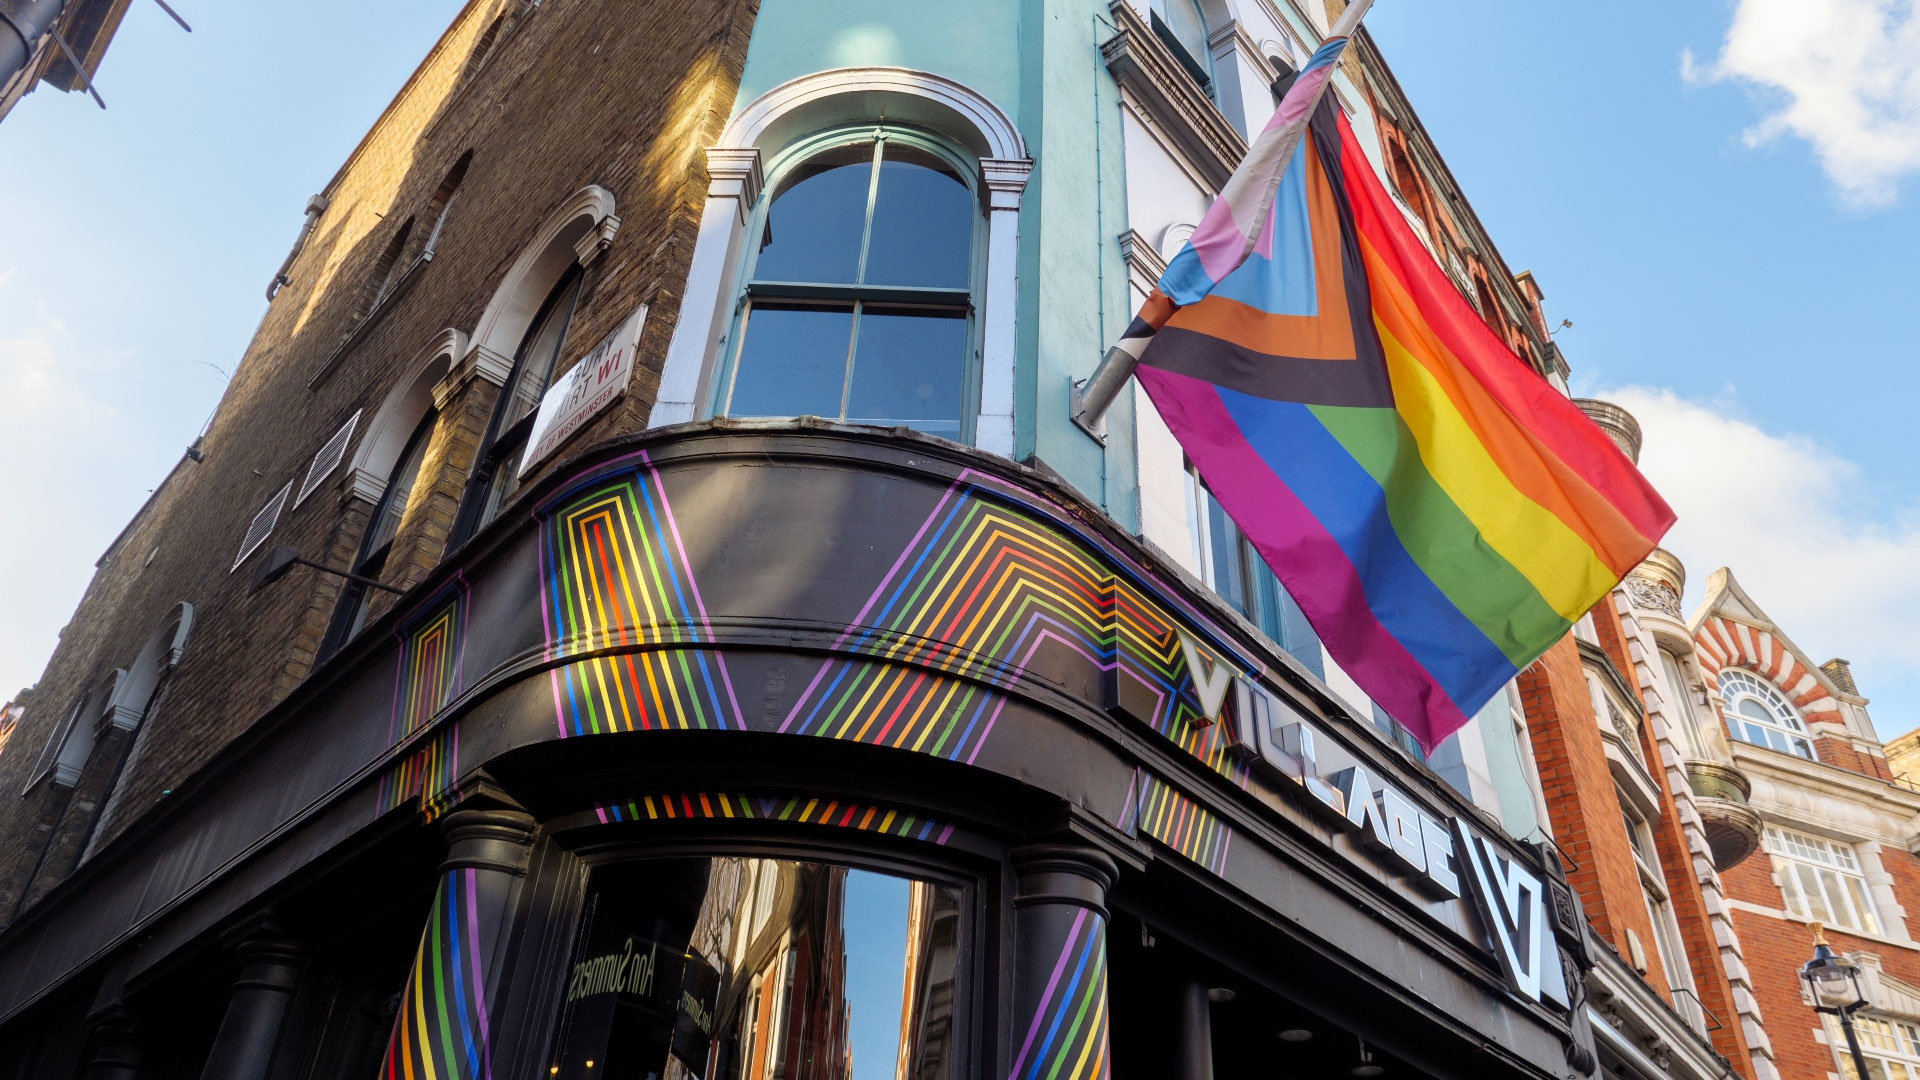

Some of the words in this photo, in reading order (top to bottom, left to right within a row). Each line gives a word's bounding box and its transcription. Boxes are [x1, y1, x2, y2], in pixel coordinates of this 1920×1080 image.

[597, 349, 622, 385] W1
[527, 444, 545, 465] CITY
[545, 433, 557, 449] OF
[557, 386, 613, 440] WESTMINSTER
[1173, 628, 1461, 899] VILLAGE
